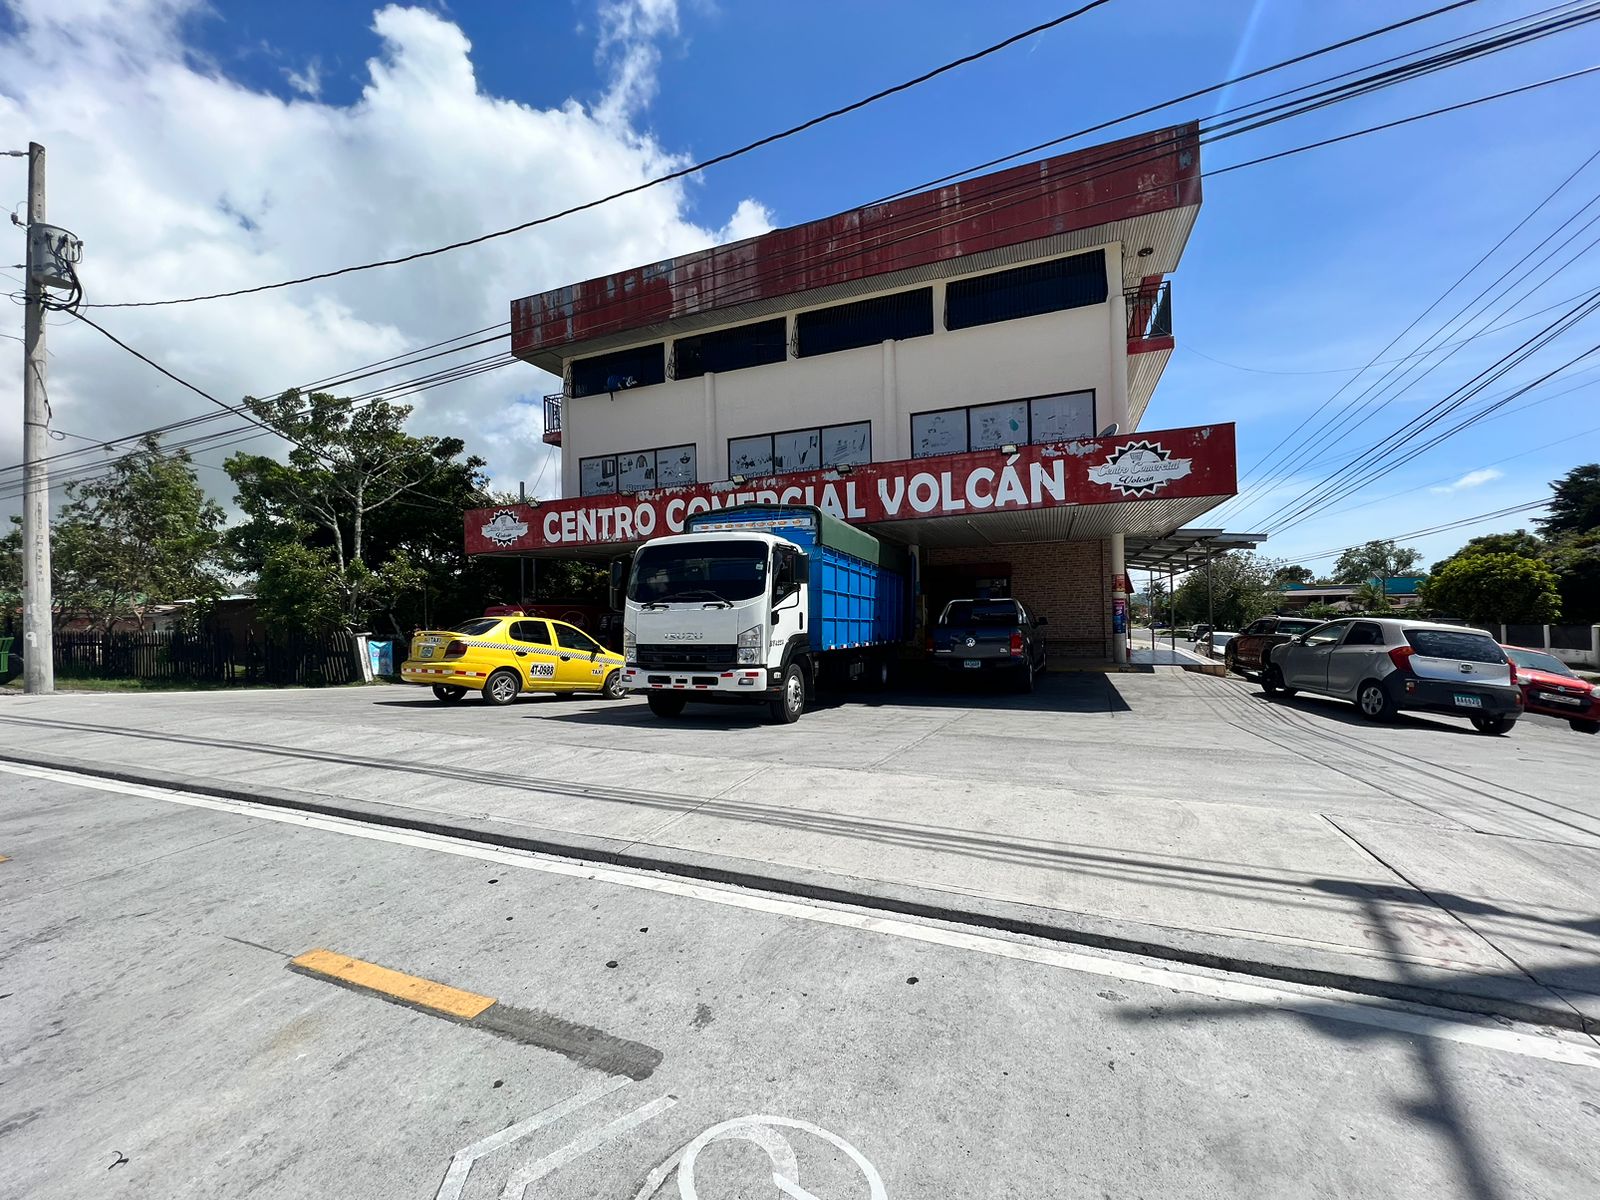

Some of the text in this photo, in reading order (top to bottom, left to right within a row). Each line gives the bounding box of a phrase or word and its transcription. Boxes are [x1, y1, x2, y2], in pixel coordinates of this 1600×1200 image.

[1098, 460, 1180, 477] Centro Comercial
[543, 502, 657, 543] CENTRO
[877, 453, 1066, 515] VOLCÁN
[664, 632, 703, 641] ISUZU
